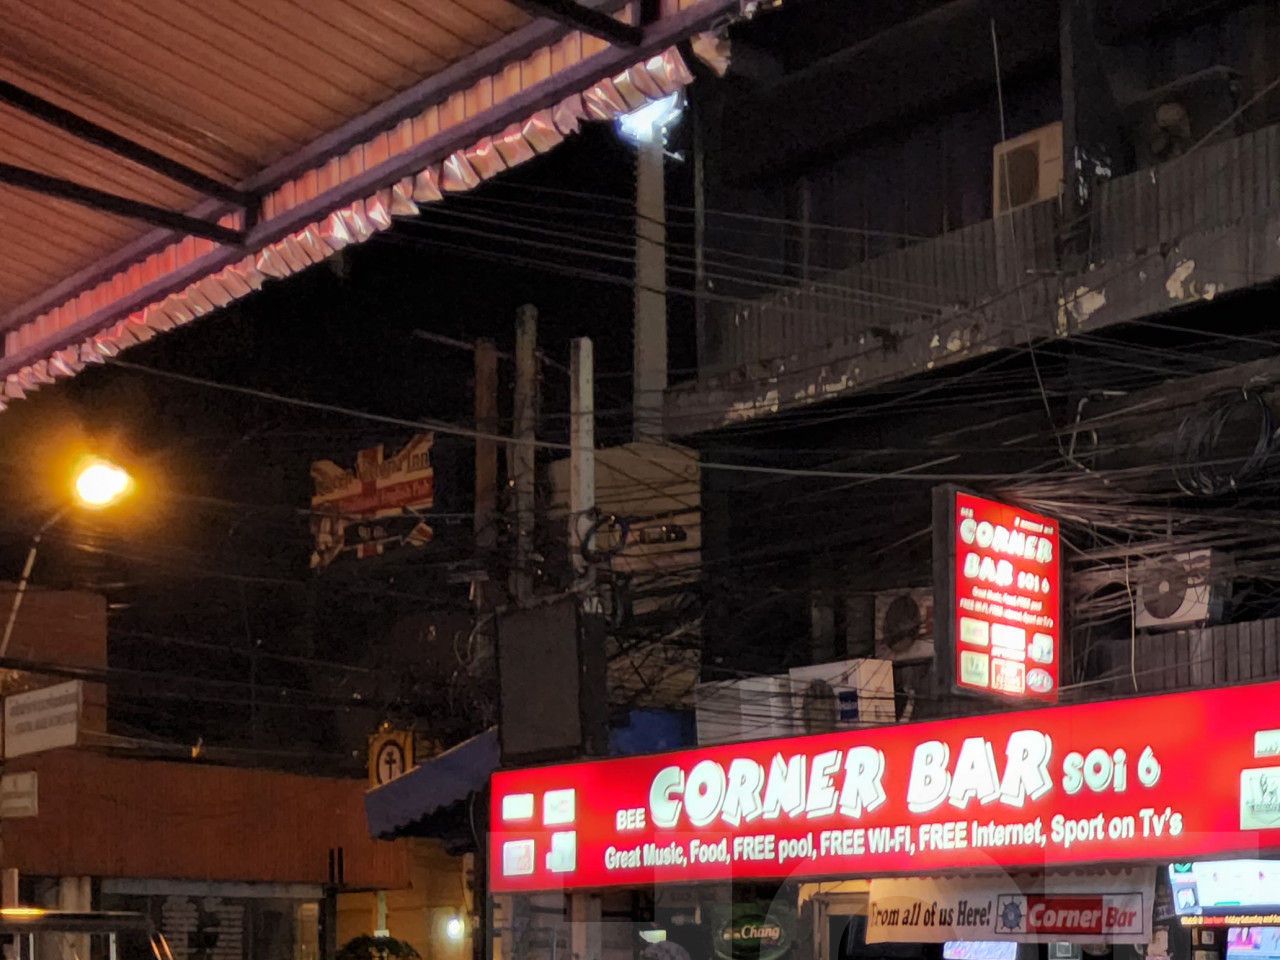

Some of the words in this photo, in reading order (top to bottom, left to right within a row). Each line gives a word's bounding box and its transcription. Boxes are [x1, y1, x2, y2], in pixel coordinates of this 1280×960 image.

[960, 518, 1053, 563] CORNER
[1041, 576, 1050, 594] 6
[616, 808, 646, 831] BEE
[649, 746, 887, 828] CORNER
[907, 730, 1053, 813] BAR
[1137, 745, 1161, 788] 6
[605, 846, 641, 870] Great
[643, 840, 687, 868] Music,
[690, 838, 730, 865] Food,
[733, 834, 776, 860] FREE
[778, 832, 817, 864] pool,
[820, 828, 865, 857] FREE
[918, 821, 968, 851] FREE
[971, 816, 1047, 848] Internet,
[1051, 812, 1105, 848] Sport
[1108, 814, 1135, 840] on
[1138, 806, 1184, 838] Tv's
[902, 901, 922, 926] all
[923, 900, 938, 927] of
[938, 906, 954, 926] us
[956, 899, 992, 927] Here!
[1028, 902, 1102, 929] Corner
[1104, 902, 1137, 928] Bar
[740, 924, 781, 940] Chang
